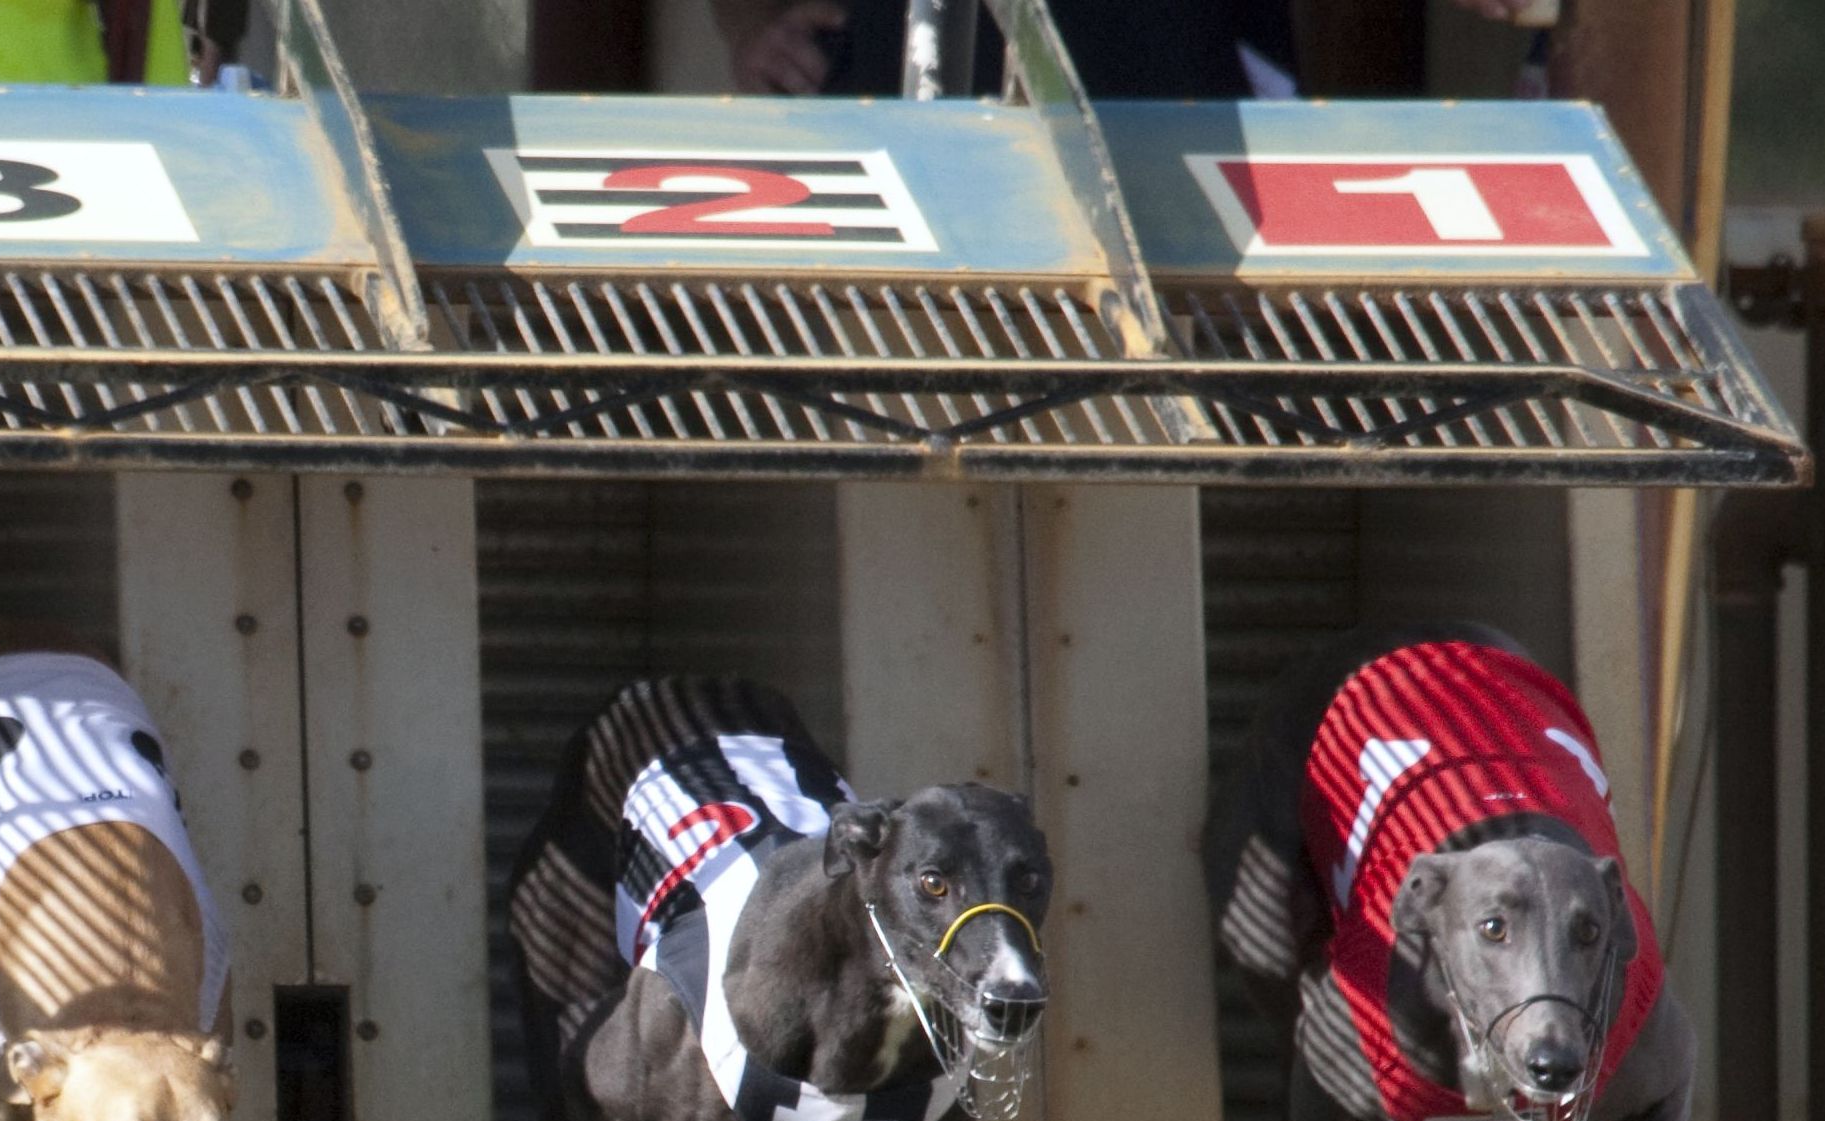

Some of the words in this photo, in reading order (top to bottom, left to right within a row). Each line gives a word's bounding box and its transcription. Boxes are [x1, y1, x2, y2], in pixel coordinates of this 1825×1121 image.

[602, 164, 835, 236] 2
[1332, 167, 1505, 241] 1
[83, 789, 129, 802] TOP
